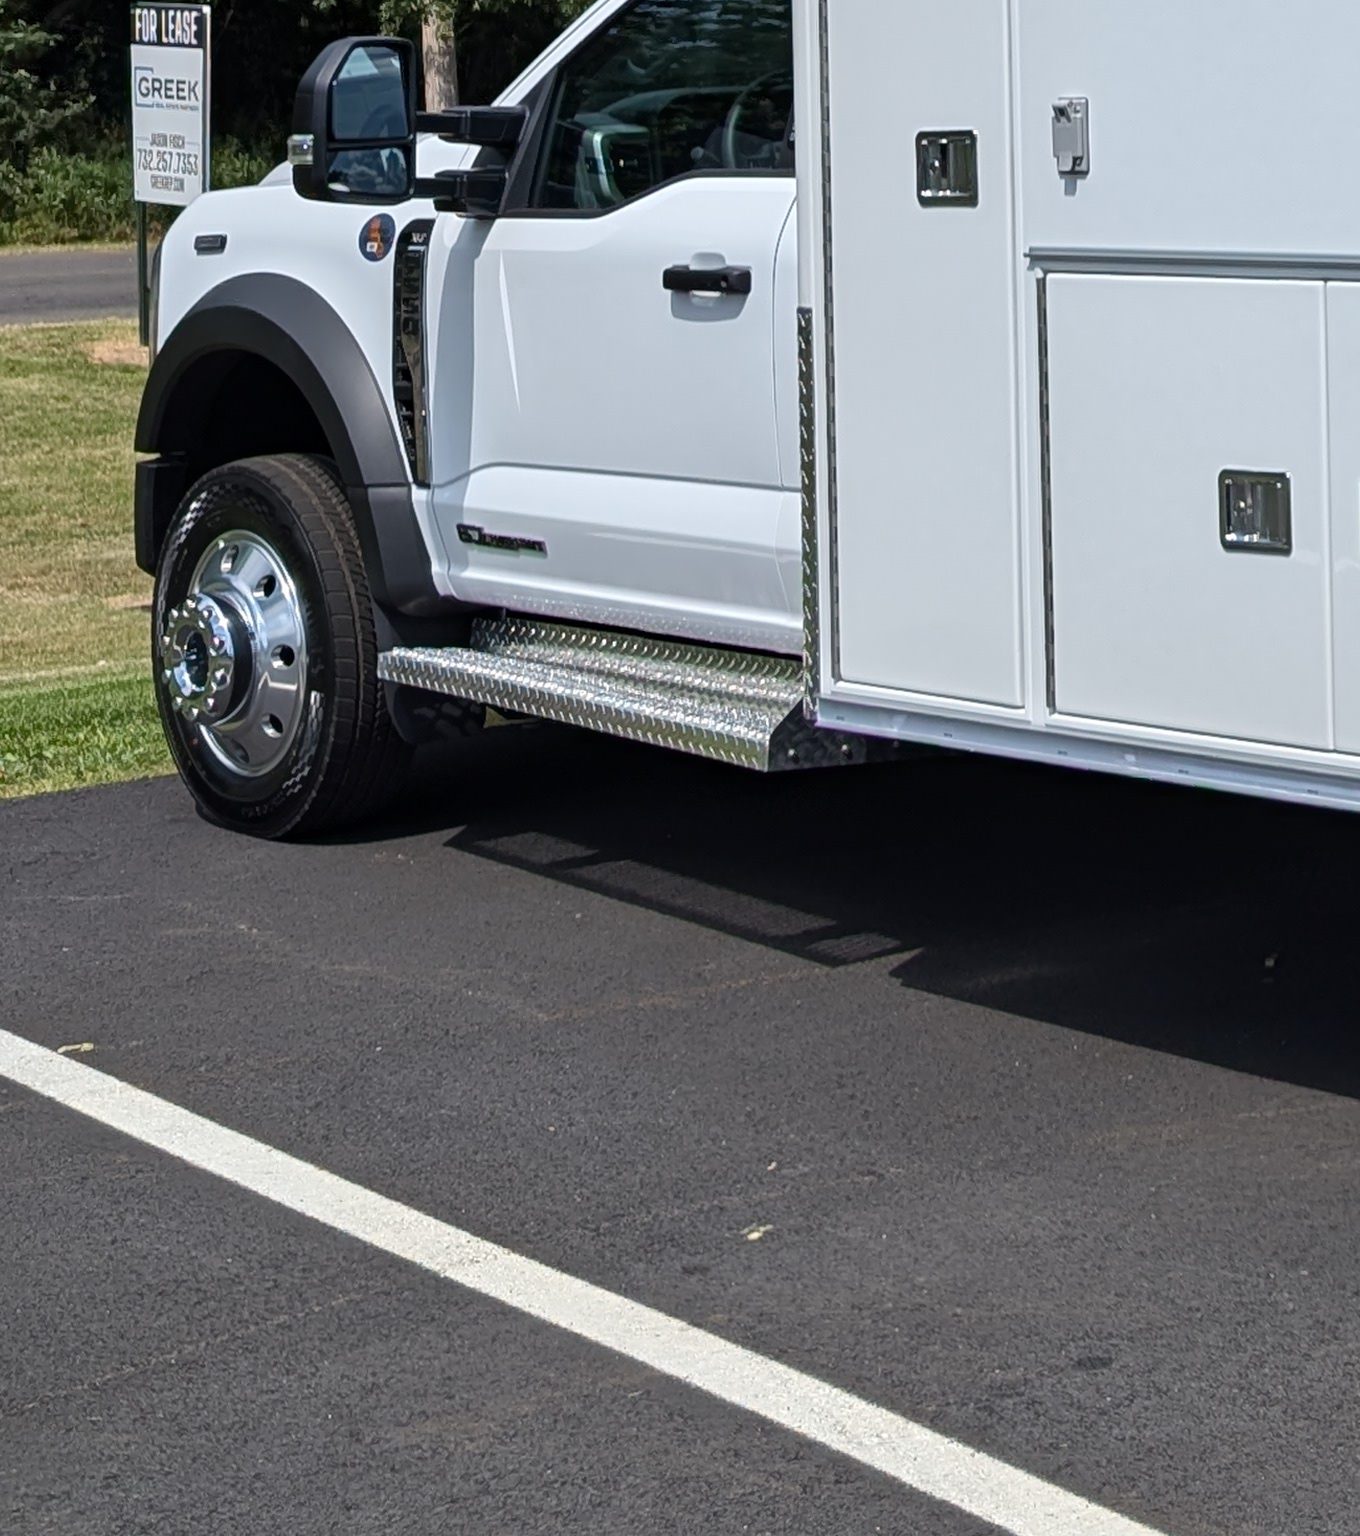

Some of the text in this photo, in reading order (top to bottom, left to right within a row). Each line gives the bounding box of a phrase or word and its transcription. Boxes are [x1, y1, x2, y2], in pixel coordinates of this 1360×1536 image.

[134, 7, 199, 45] FOR LEASE
[138, 76, 199, 102] GREEK
[137, 148, 199, 176] 732.257.7353
